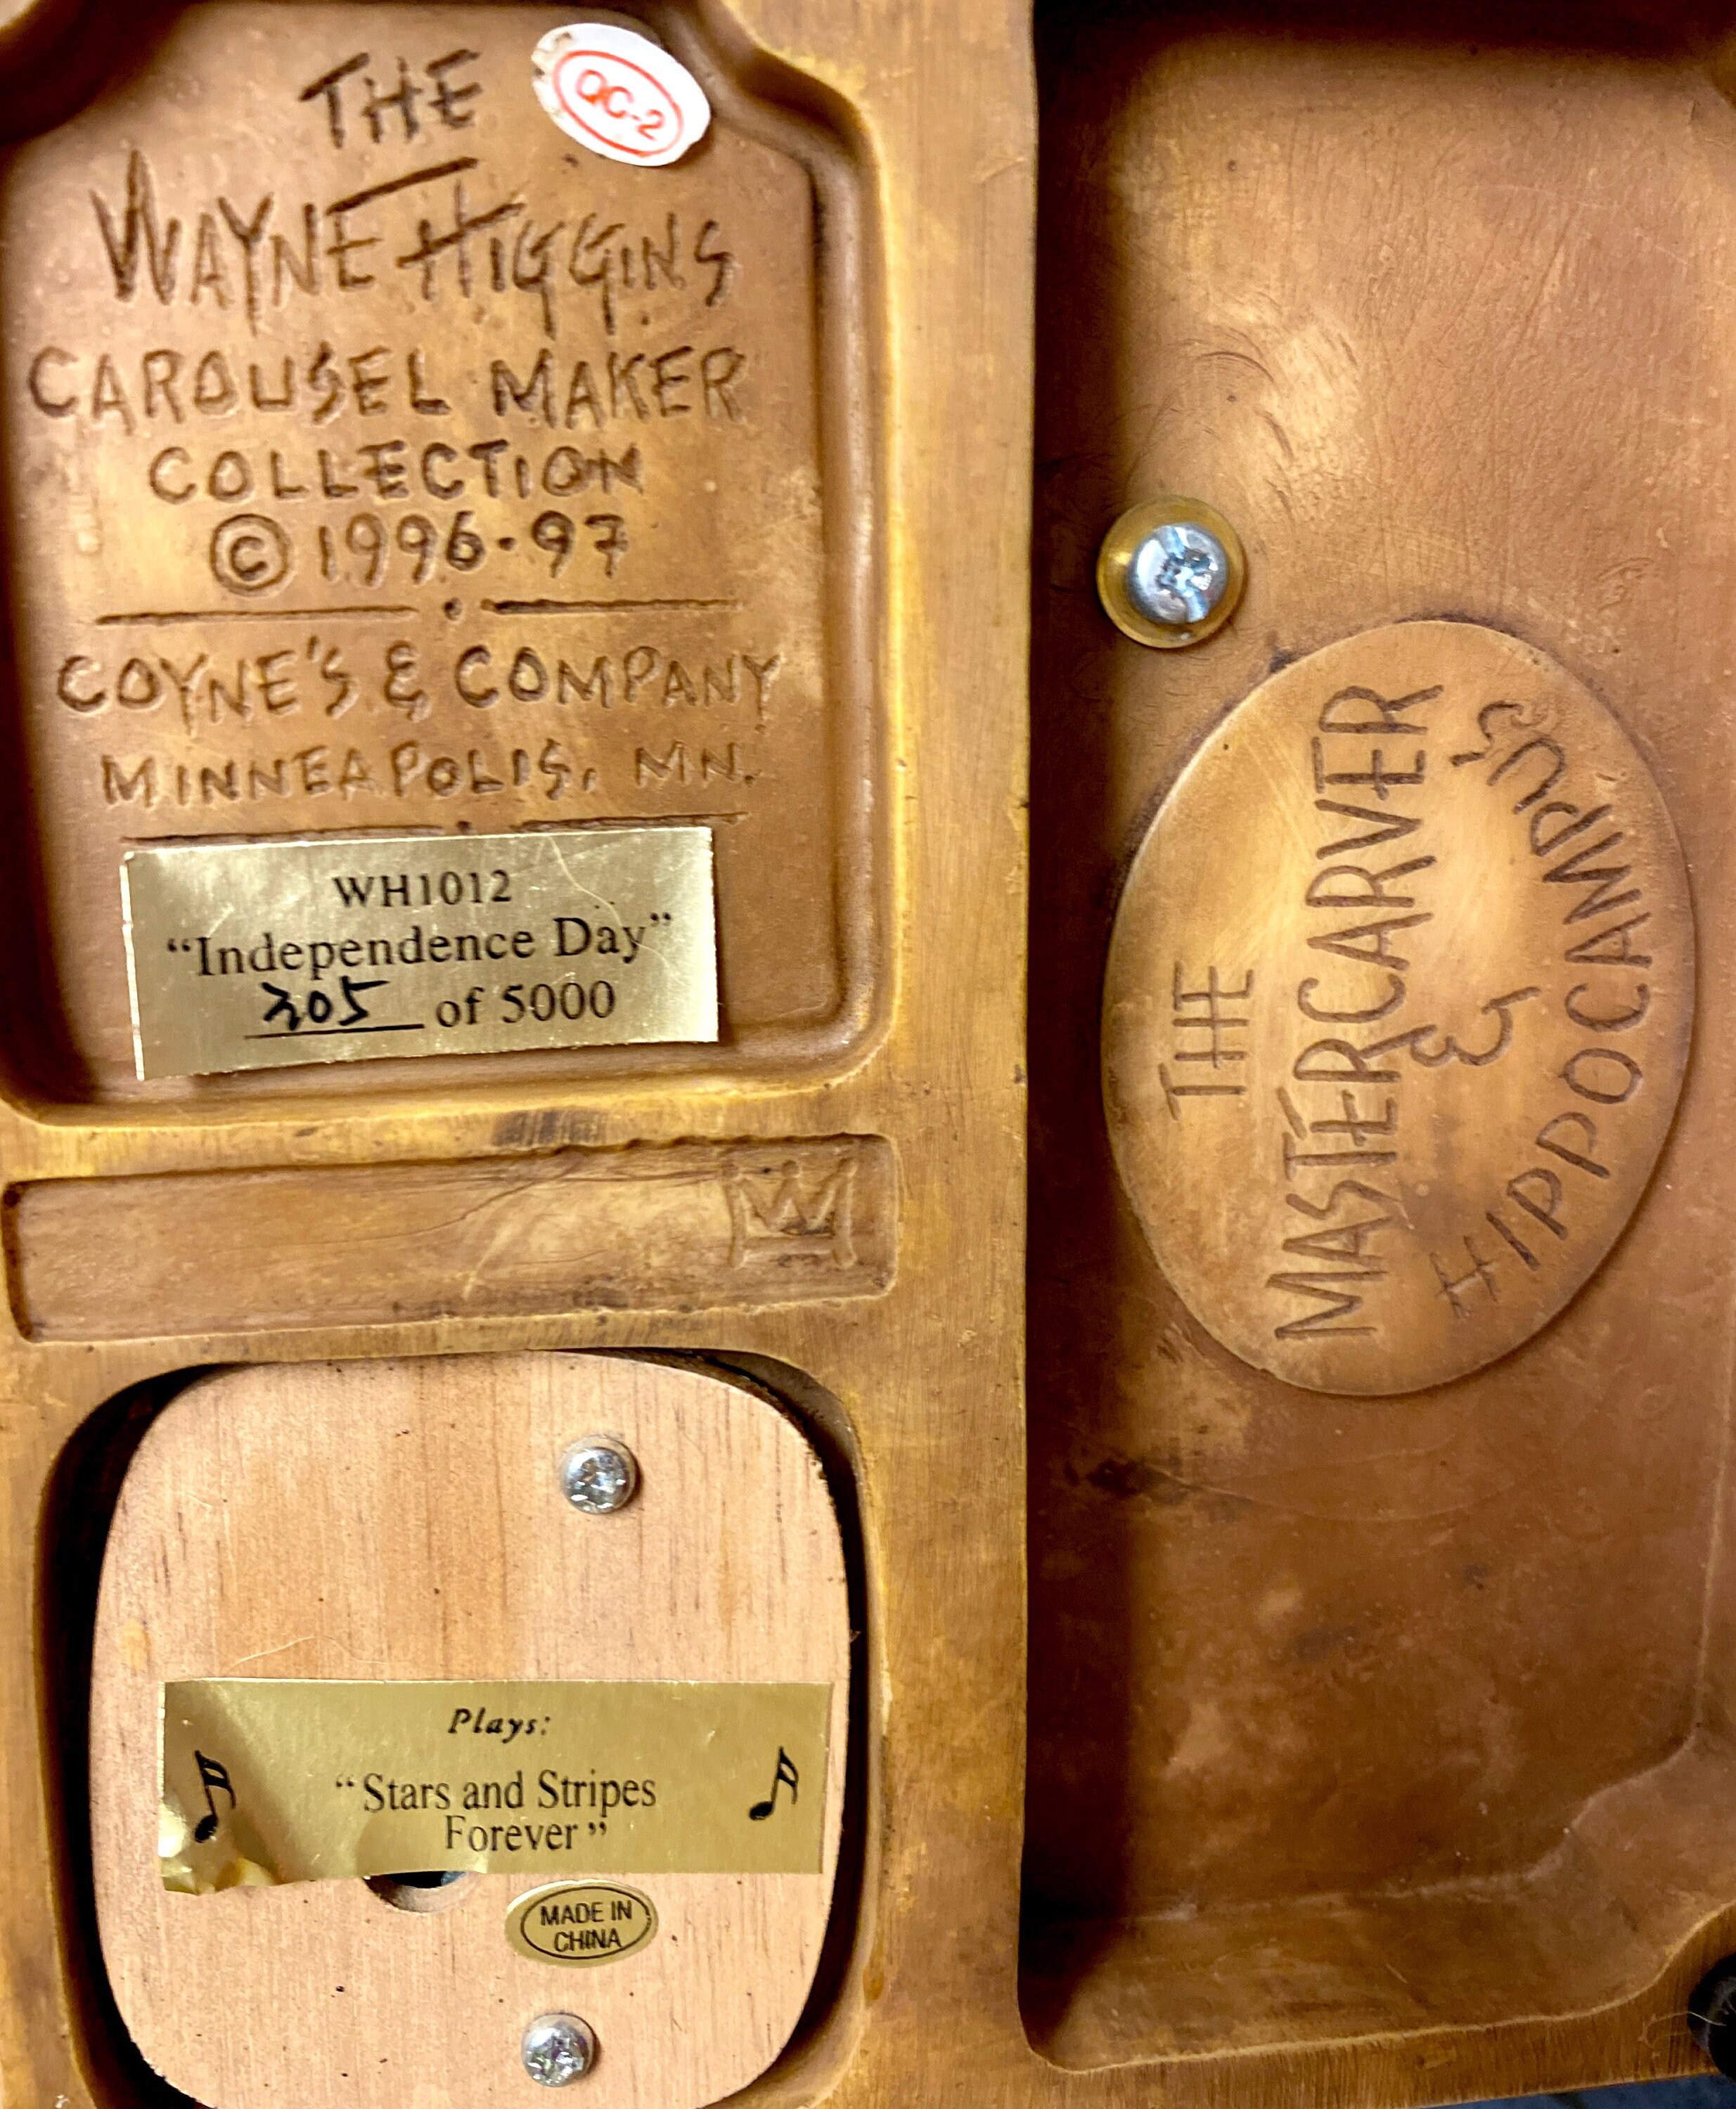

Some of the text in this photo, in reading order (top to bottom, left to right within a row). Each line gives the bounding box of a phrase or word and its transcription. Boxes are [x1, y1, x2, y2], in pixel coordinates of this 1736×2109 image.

[300, 48, 484, 149] THE
[575, 69, 665, 141] QC-2
[90, 149, 735, 339] WAYNE HIGGINS
[28, 343, 747, 434] CAROUSEL MAKER
[149, 439, 643, 505] COLLECTION
[56, 636, 785, 737] COYNE'S & COMPANY
[633, 740, 762, 787] MN.
[333, 869, 512, 907] WH1012
[435, 987, 485, 1028] of
[502, 979, 616, 1025] 5000
[1159, 959, 1257, 1119] THE
[1266, 683, 1446, 1341] MASTERCARVER
[1410, 984, 1541, 1069] &
[1427, 699, 1652, 1319] HIPPOCAMPUS
[447, 1707, 553, 1743] Plays:
[461, 1771, 525, 1810] and
[536, 1769, 657, 1815] Stripes
[539, 1900, 634, 1926] MADE IN
[553, 1930, 623, 1952] CHINA
